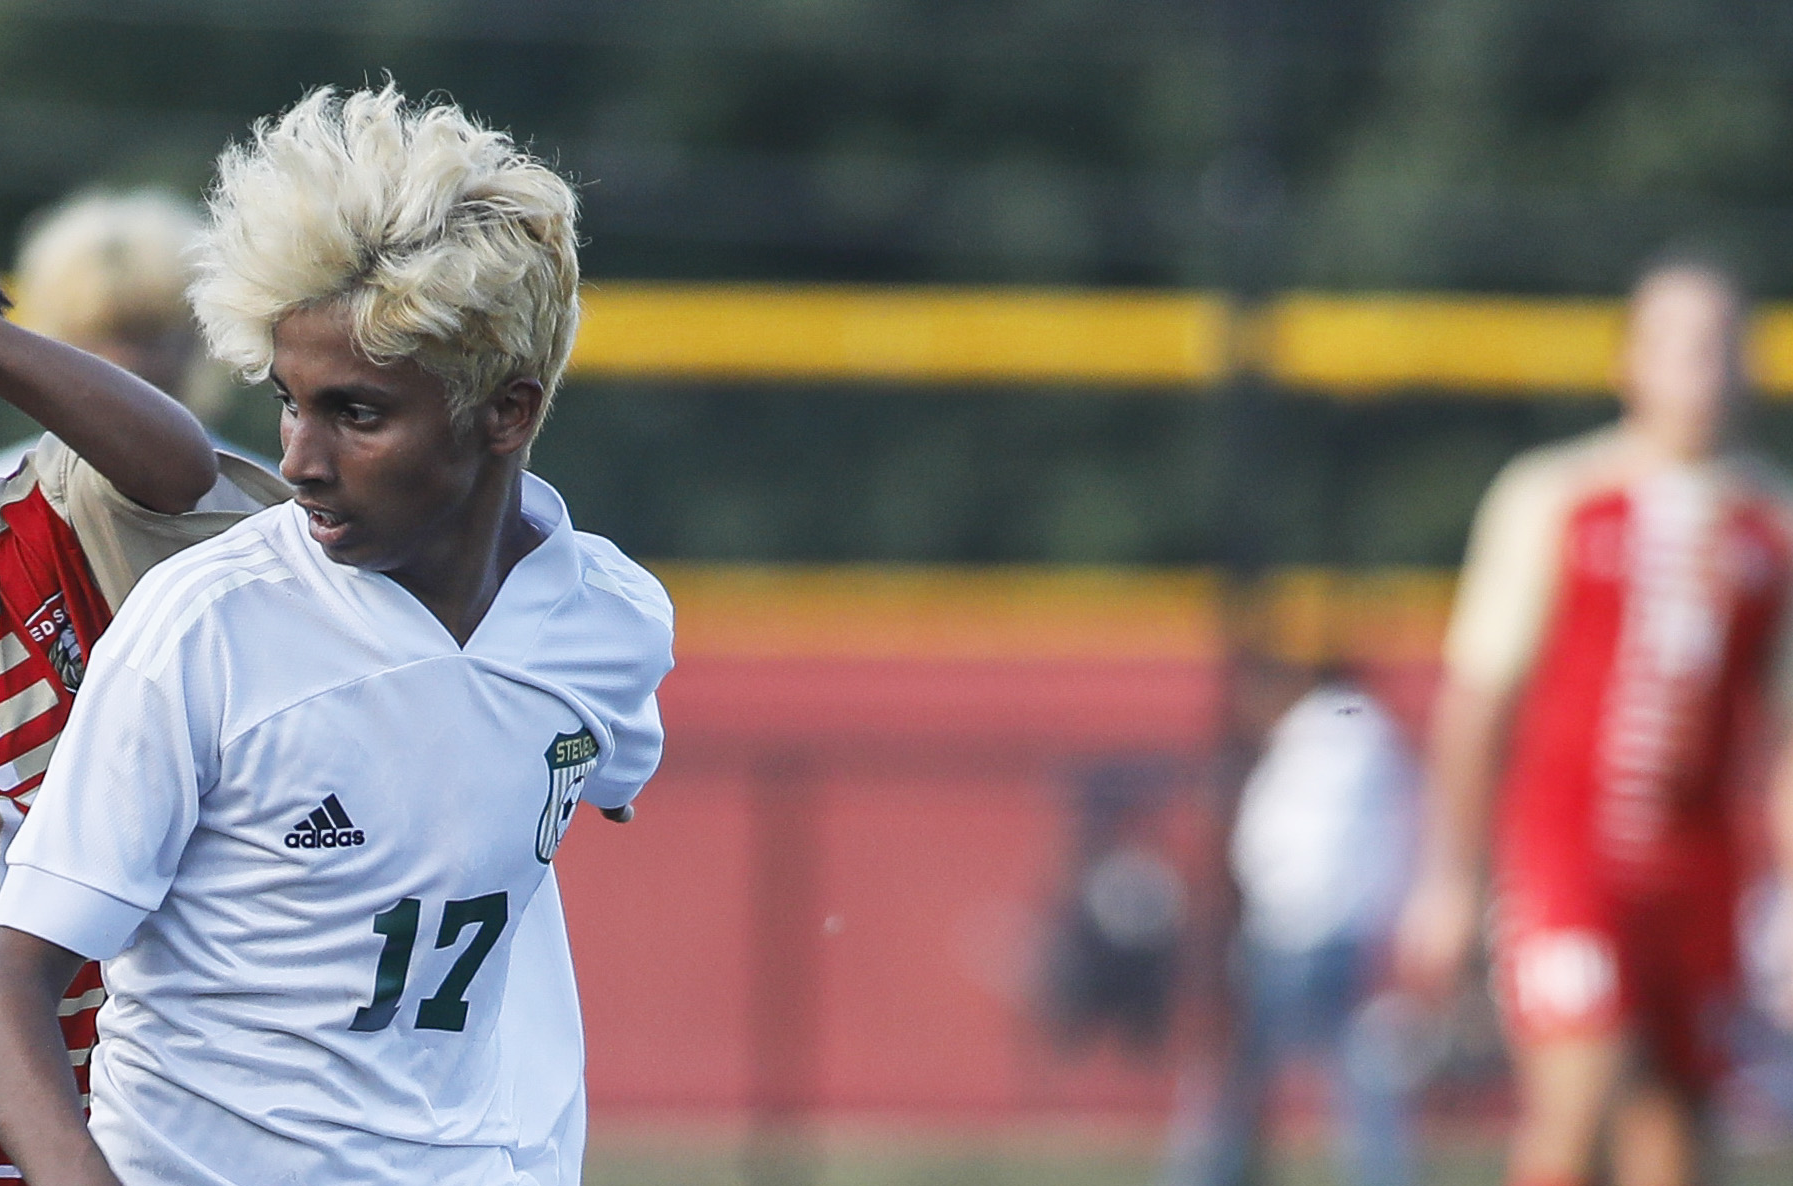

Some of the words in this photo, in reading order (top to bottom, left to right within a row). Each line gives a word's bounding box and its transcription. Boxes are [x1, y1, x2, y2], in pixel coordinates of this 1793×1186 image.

[29, 607, 67, 642] EDS
[284, 829, 365, 848] adidas
[348, 891, 508, 1032] 17
